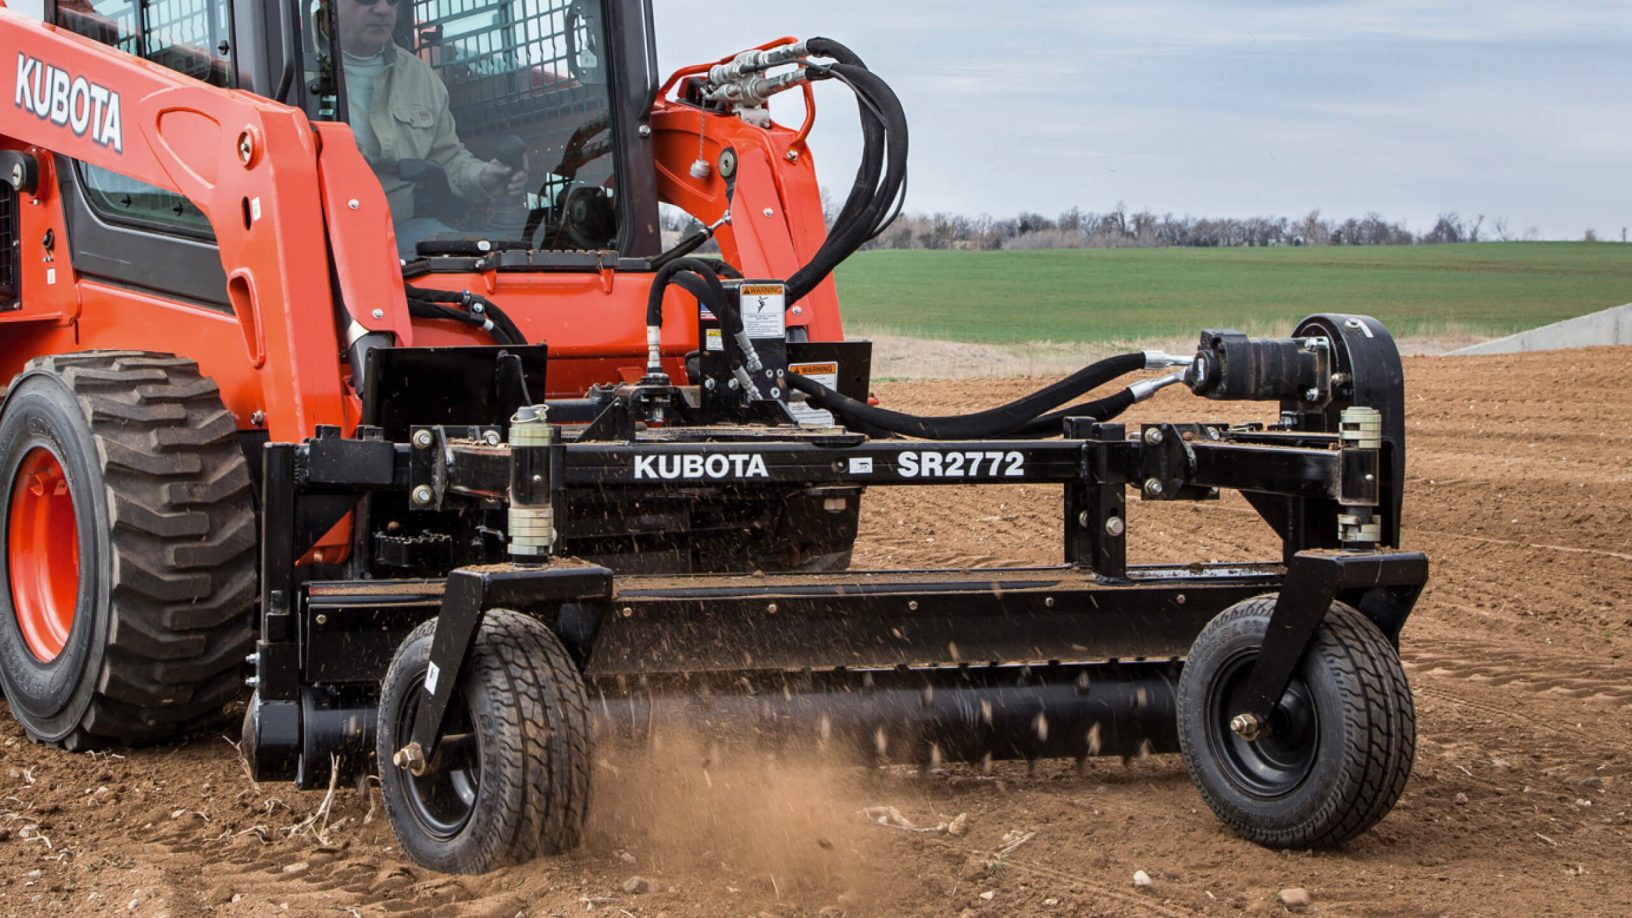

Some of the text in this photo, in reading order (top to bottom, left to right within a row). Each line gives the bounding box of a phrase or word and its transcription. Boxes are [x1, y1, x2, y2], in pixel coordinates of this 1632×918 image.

[15, 52, 123, 154] KUBOTA
[750, 286, 783, 295] WARNING
[801, 364, 833, 374] WARNING
[634, 453, 769, 479] KUBOTA
[897, 451, 1025, 477] SR2772
